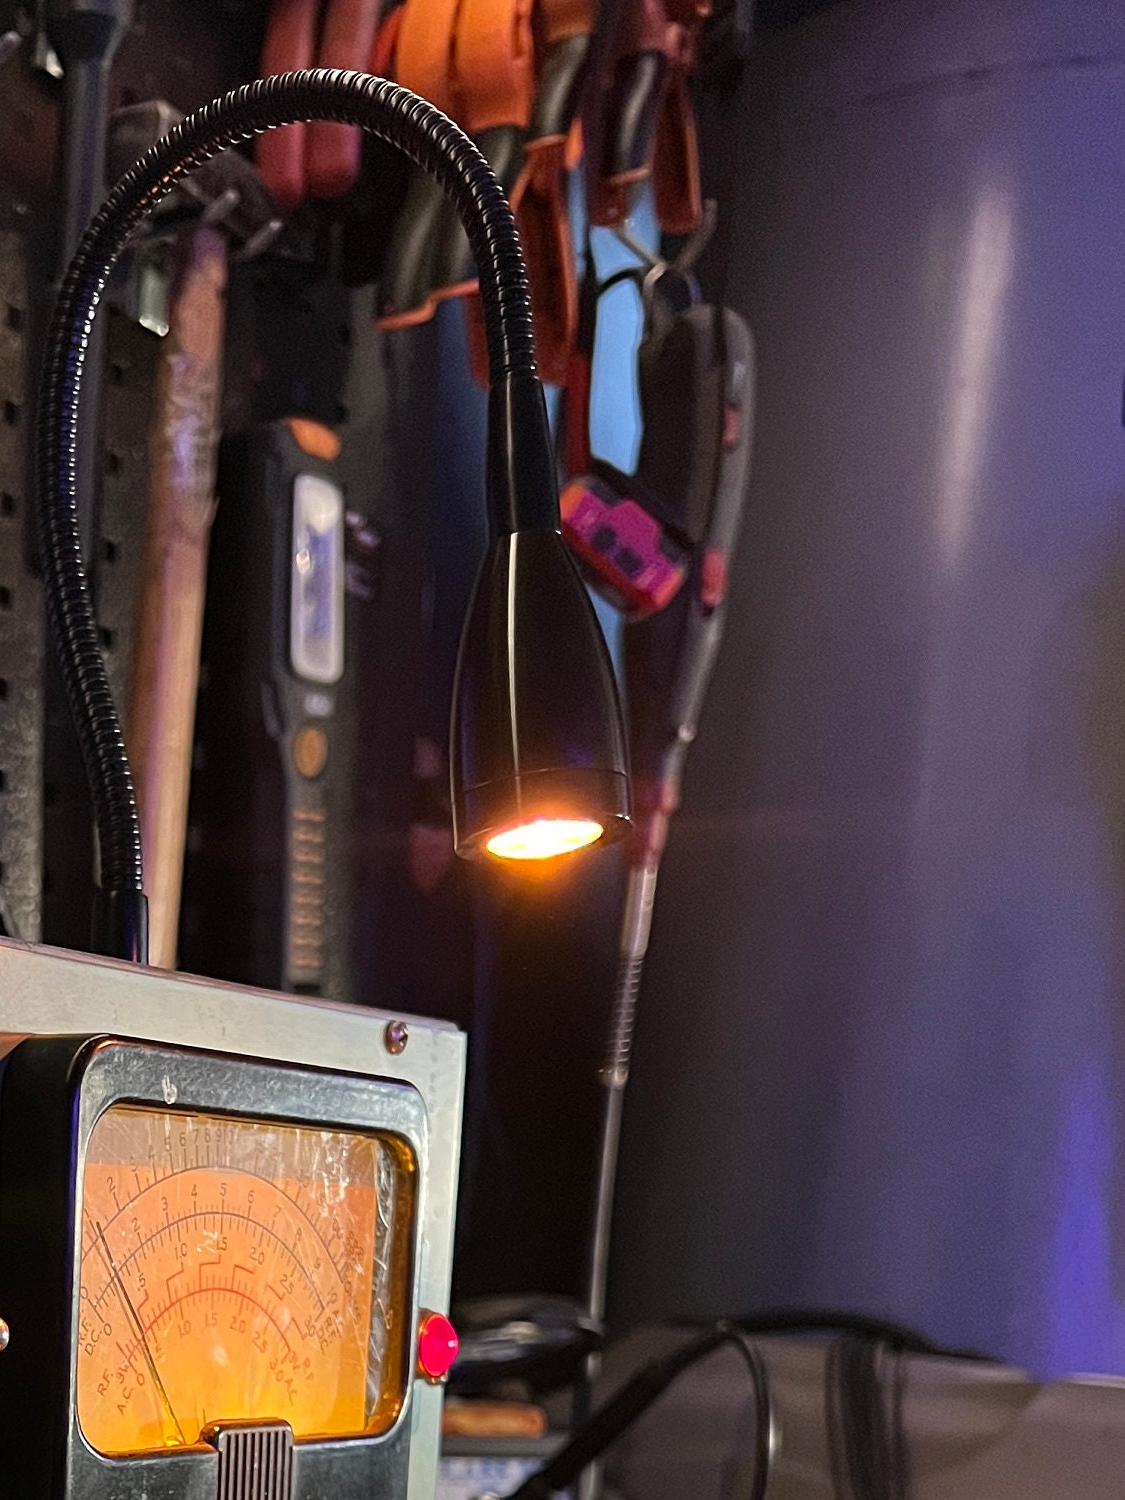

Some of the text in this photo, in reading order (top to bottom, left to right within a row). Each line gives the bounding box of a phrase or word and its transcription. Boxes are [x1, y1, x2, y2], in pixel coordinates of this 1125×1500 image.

[106, 1176, 116, 1193] 2
[179, 1132, 187, 1147] 6
[192, 1128, 200, 1144] 7
[204, 1127, 212, 1143] 8
[215, 1127, 222, 1143] 9
[131, 1216, 141, 1233] 2
[161, 1196, 169, 1212] 3
[190, 1183, 198, 1197] 4
[219, 1182, 228, 1197] 5
[247, 1189, 255, 1204] 6
[274, 1205, 282, 1218] 7
[103, 1322, 113, 1337] 0
[136, 1372, 146, 1387] 0
